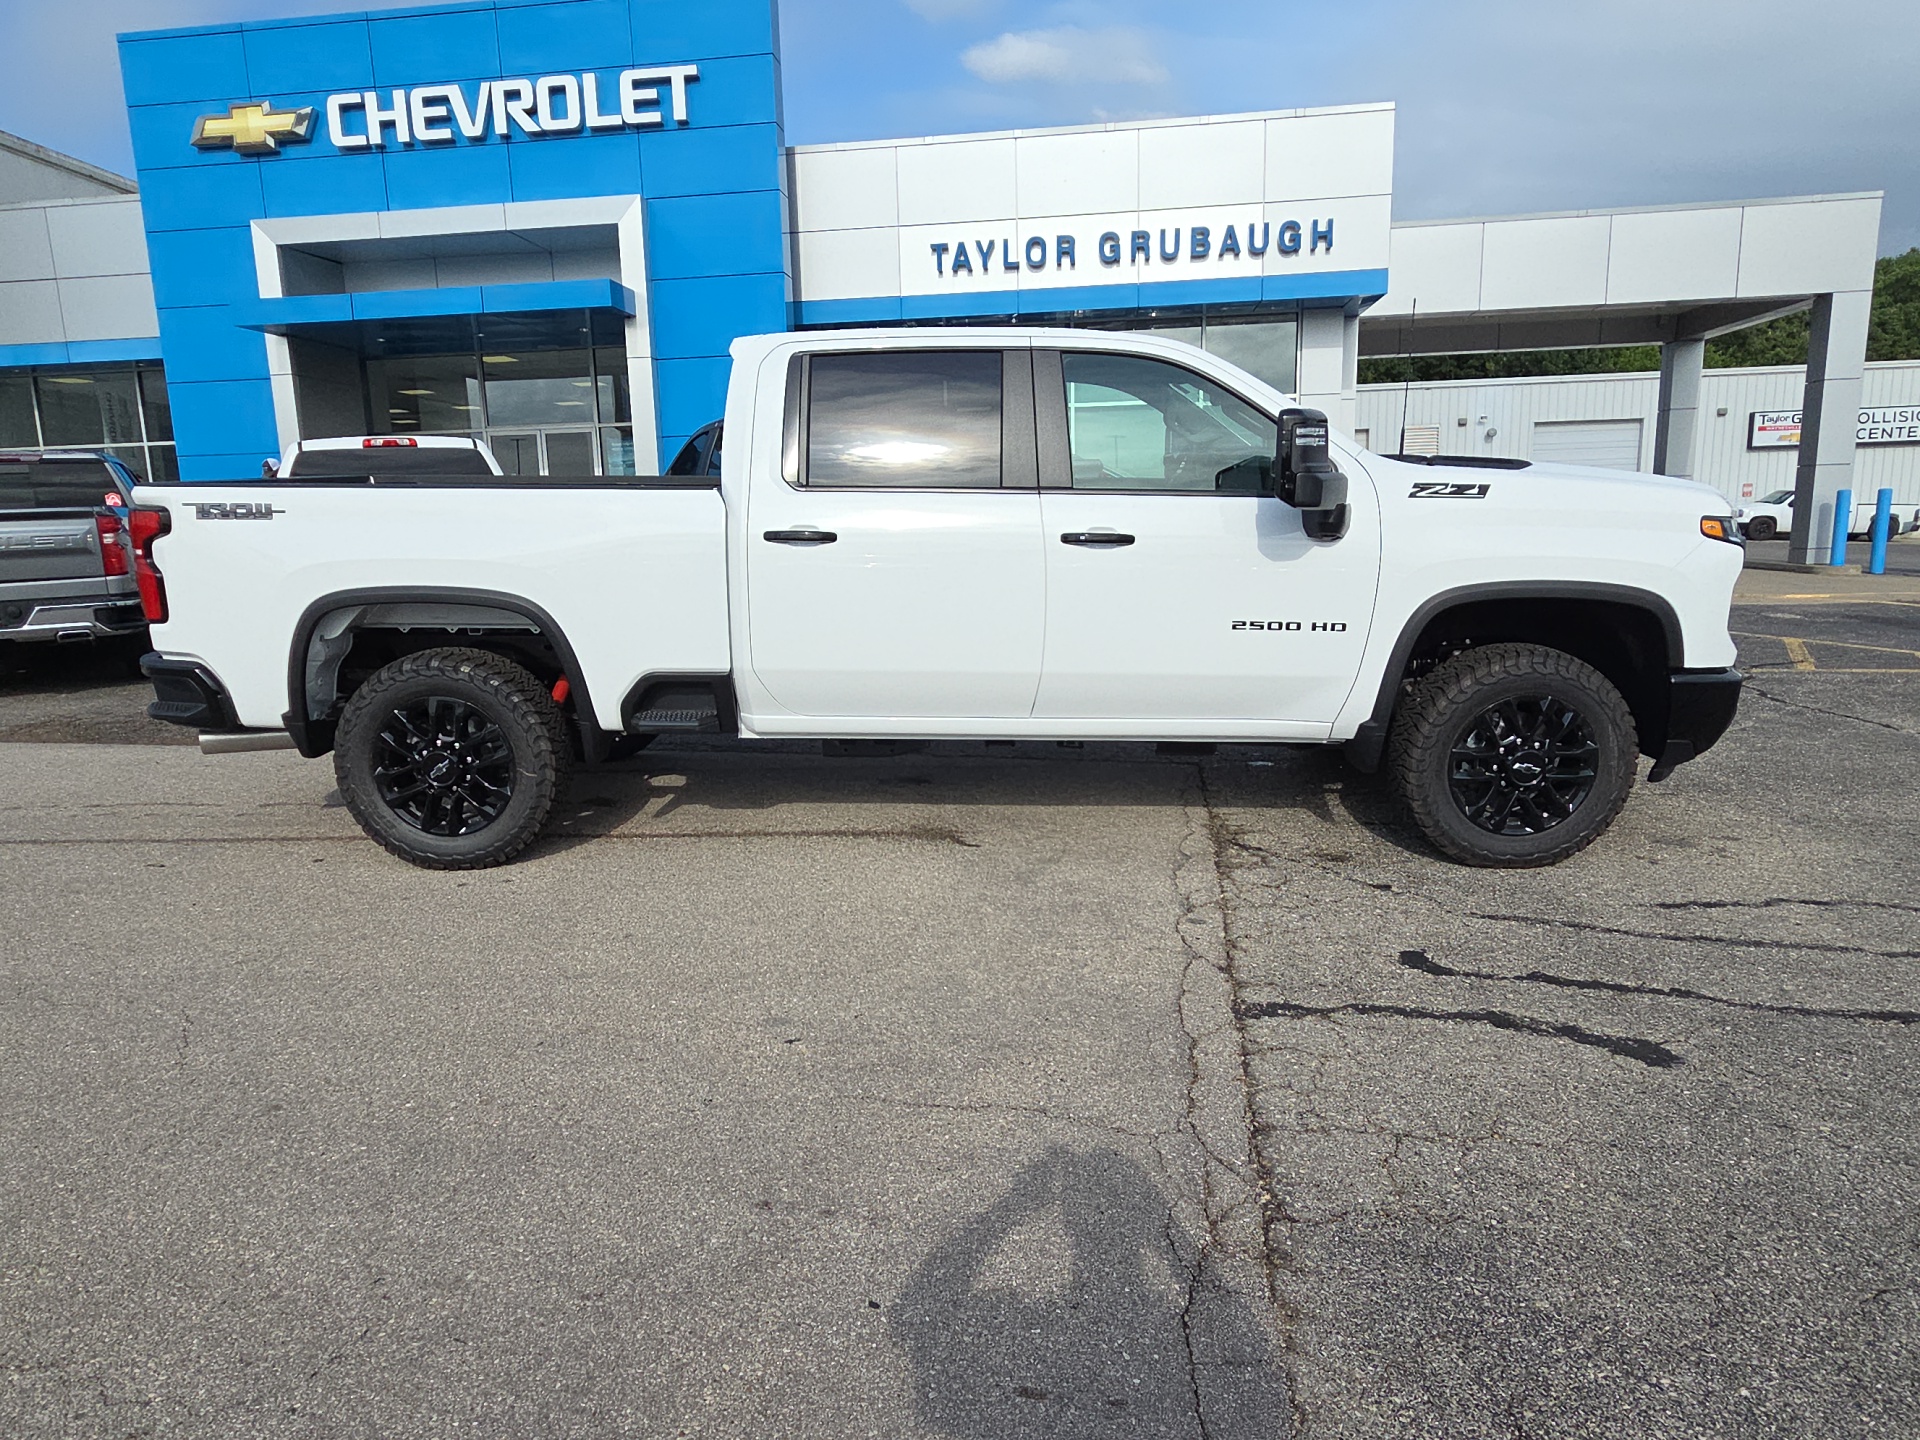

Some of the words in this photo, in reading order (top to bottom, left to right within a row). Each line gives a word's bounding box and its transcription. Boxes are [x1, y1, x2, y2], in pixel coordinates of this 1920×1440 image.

[326, 63, 699, 149] CHEVROLET
[930, 233, 1076, 277] TAYLOR
[1099, 217, 1336, 266] GRUBAUGH
[1759, 414, 1790, 425] Taylor
[1857, 410, 1920, 424] OLLISI
[1856, 425, 1920, 440] CENTE
[1408, 482, 1492, 499] Z71
[1231, 620, 1302, 631] 2500
[1311, 621, 1347, 632] HD
